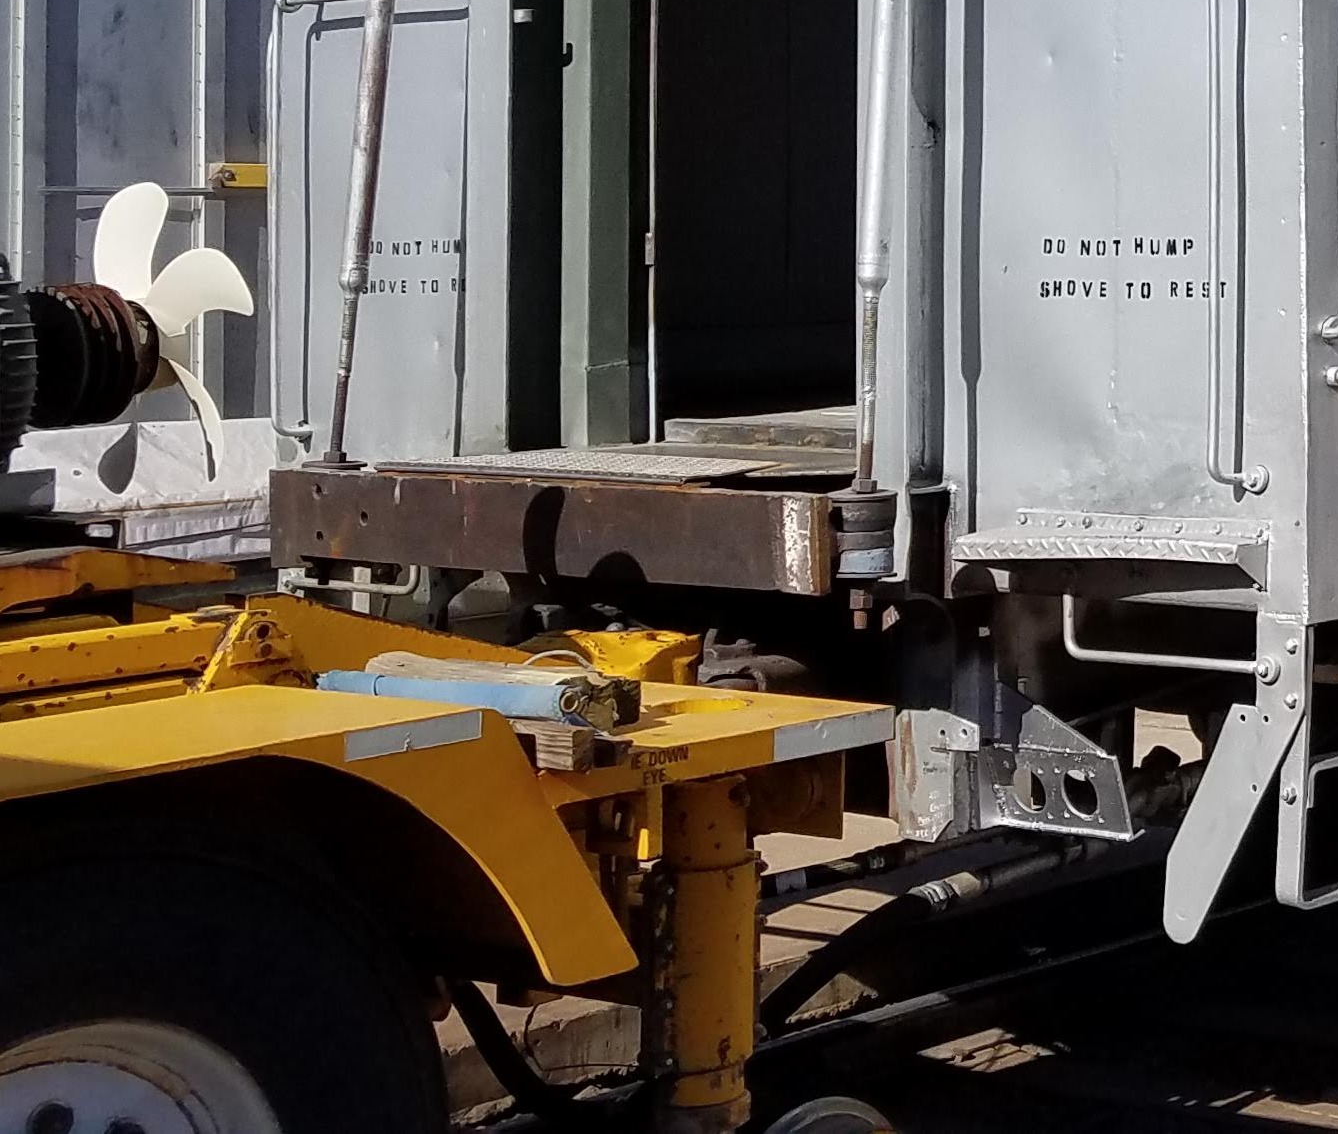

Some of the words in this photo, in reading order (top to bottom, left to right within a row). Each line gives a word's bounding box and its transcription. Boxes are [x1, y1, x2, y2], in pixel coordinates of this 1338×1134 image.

[392, 241, 422, 255] NOT
[431, 239, 467, 254] HUM
[1043, 239, 1065, 254] DO
[1080, 240, 1121, 256] NOT
[1134, 238, 1194, 256] HUMP
[420, 280, 438, 294] TO
[1040, 280, 1107, 298] SHOVE
[1126, 282, 1151, 299] TO
[1170, 281, 1227, 298] REST
[649, 746, 689, 766] DOWN
[643, 768, 667, 785] EYE
